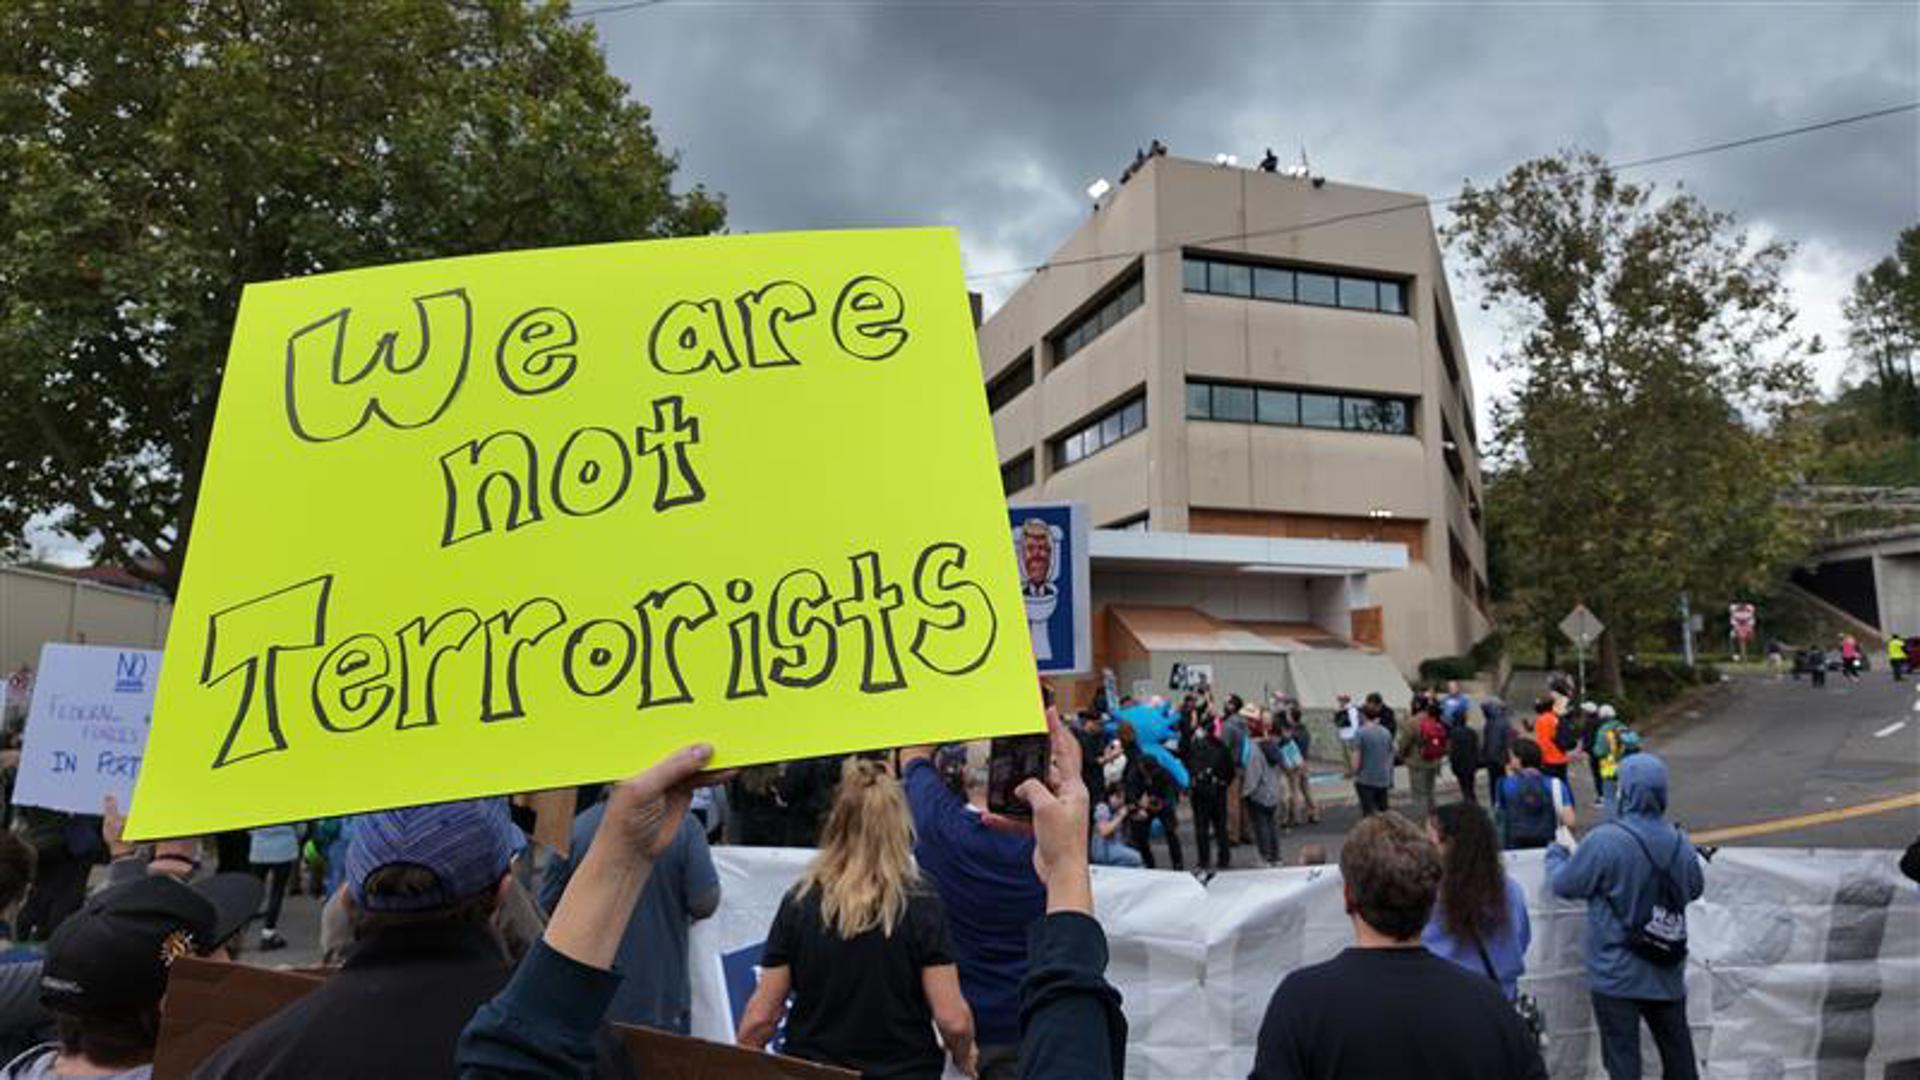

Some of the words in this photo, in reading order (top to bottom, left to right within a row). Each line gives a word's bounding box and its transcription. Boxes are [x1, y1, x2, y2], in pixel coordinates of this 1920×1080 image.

[285, 287, 578, 443] We
[647, 275, 909, 375] are
[440, 395, 706, 548] not
[116, 651, 147, 677] NO
[199, 542, 998, 769] Terrorists
[52, 751, 78, 774] IN
